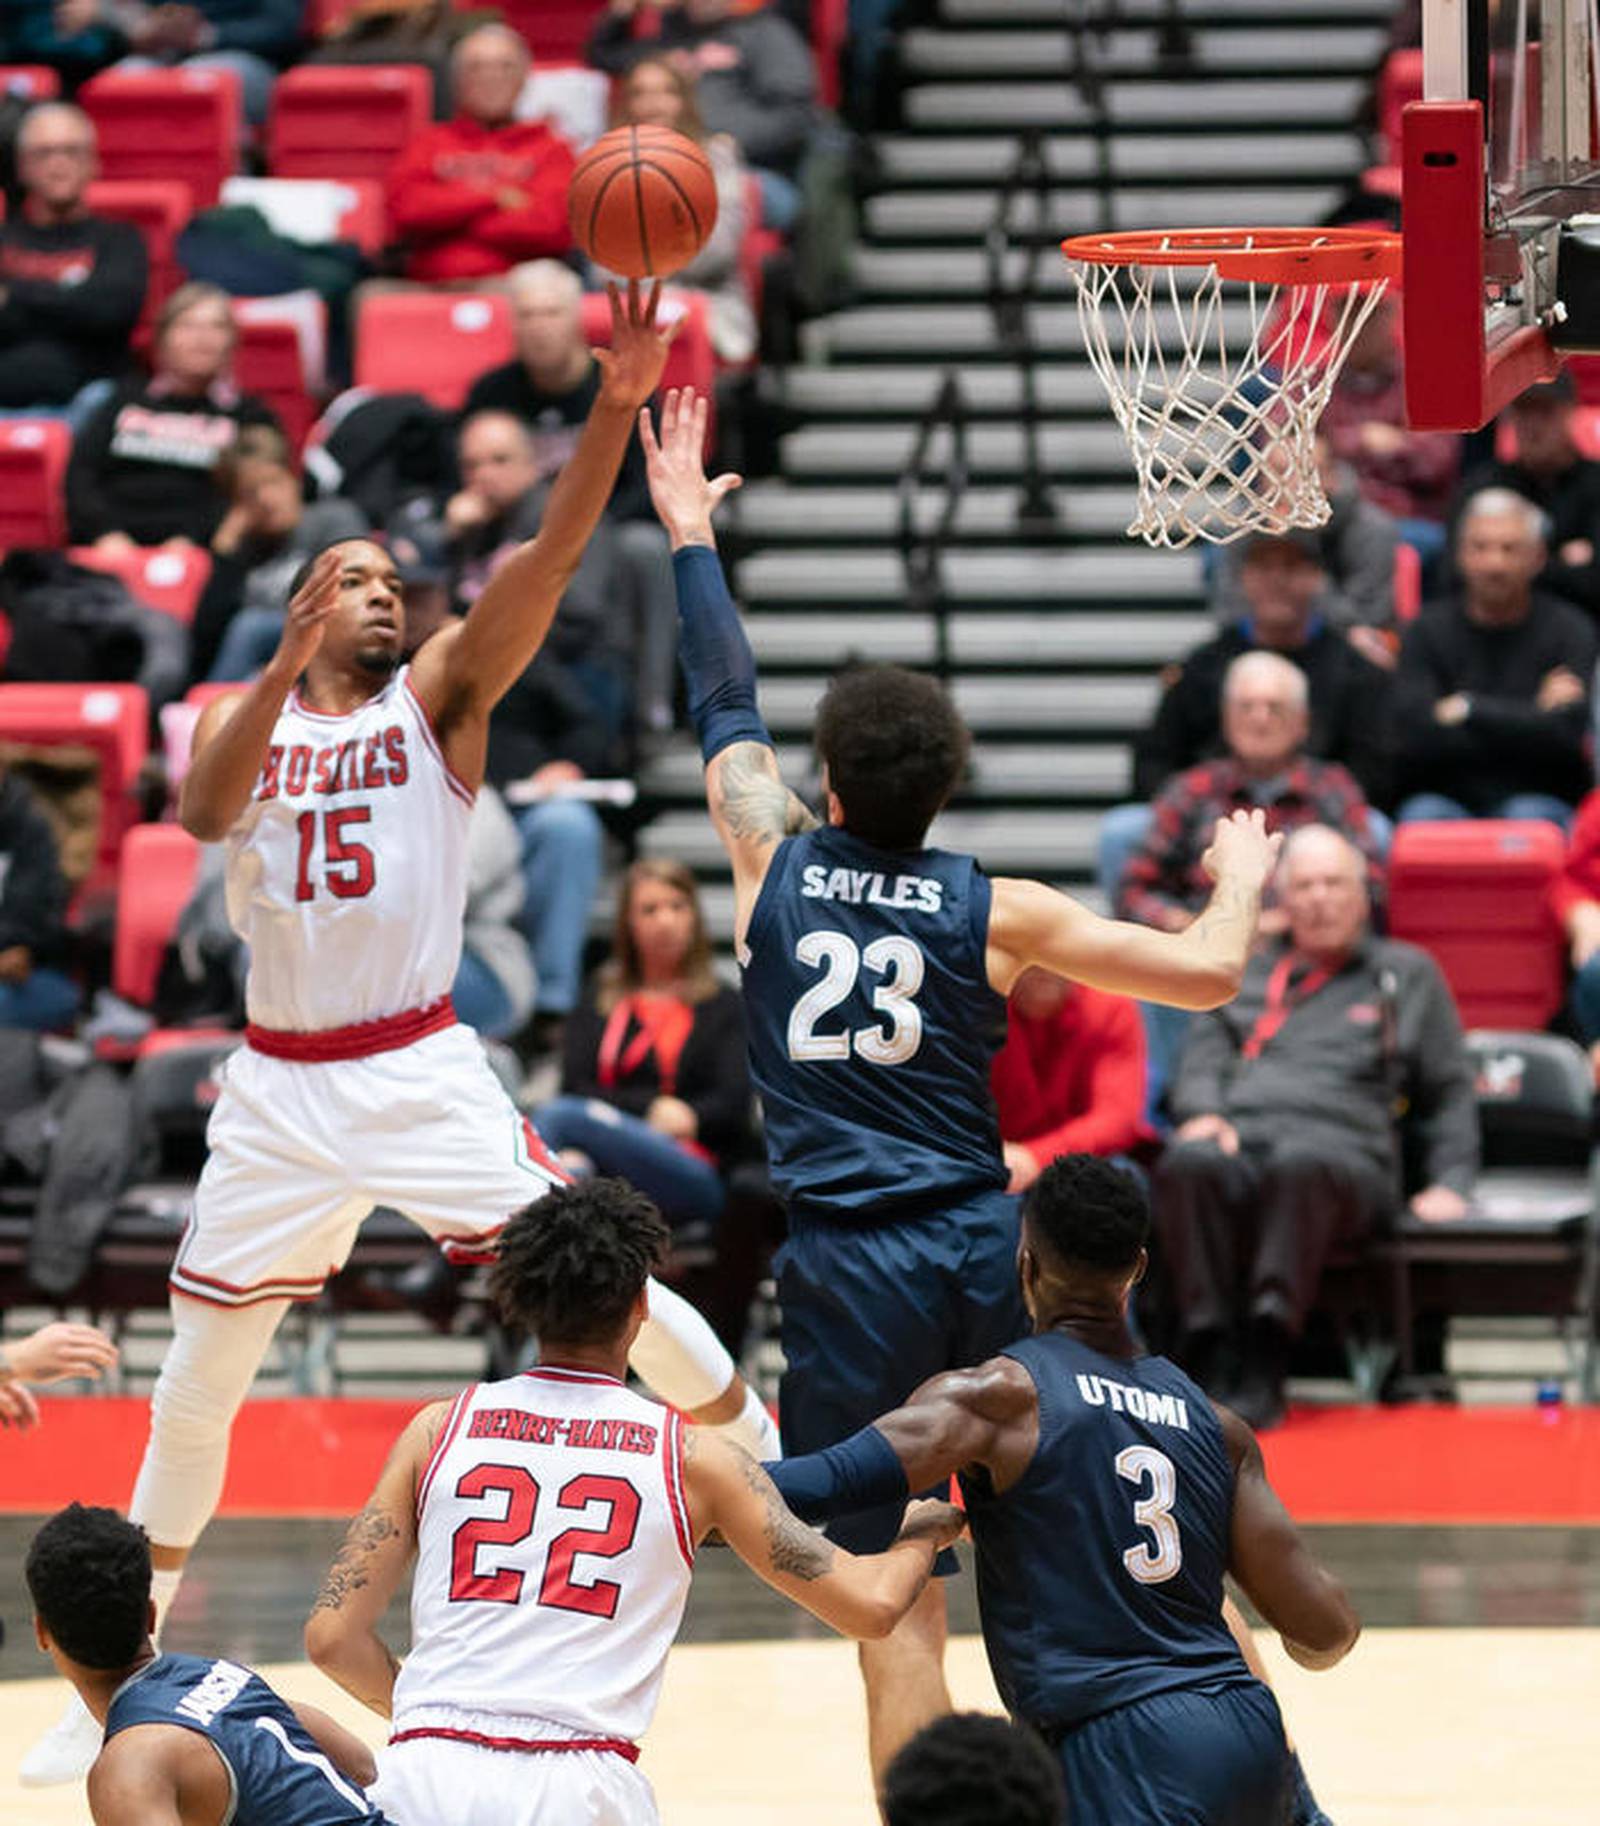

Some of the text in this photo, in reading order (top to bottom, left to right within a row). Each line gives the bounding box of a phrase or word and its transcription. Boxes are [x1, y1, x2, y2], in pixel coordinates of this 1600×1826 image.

[296, 804, 376, 902] 15
[802, 865, 943, 913] SAYLES
[787, 931, 925, 1065] 23
[467, 1408, 658, 1455] HENRY-HAYES
[1076, 1374, 1190, 1431] UTOMI
[448, 1462, 642, 1620] 22
[1115, 1445, 1182, 1584] 3
